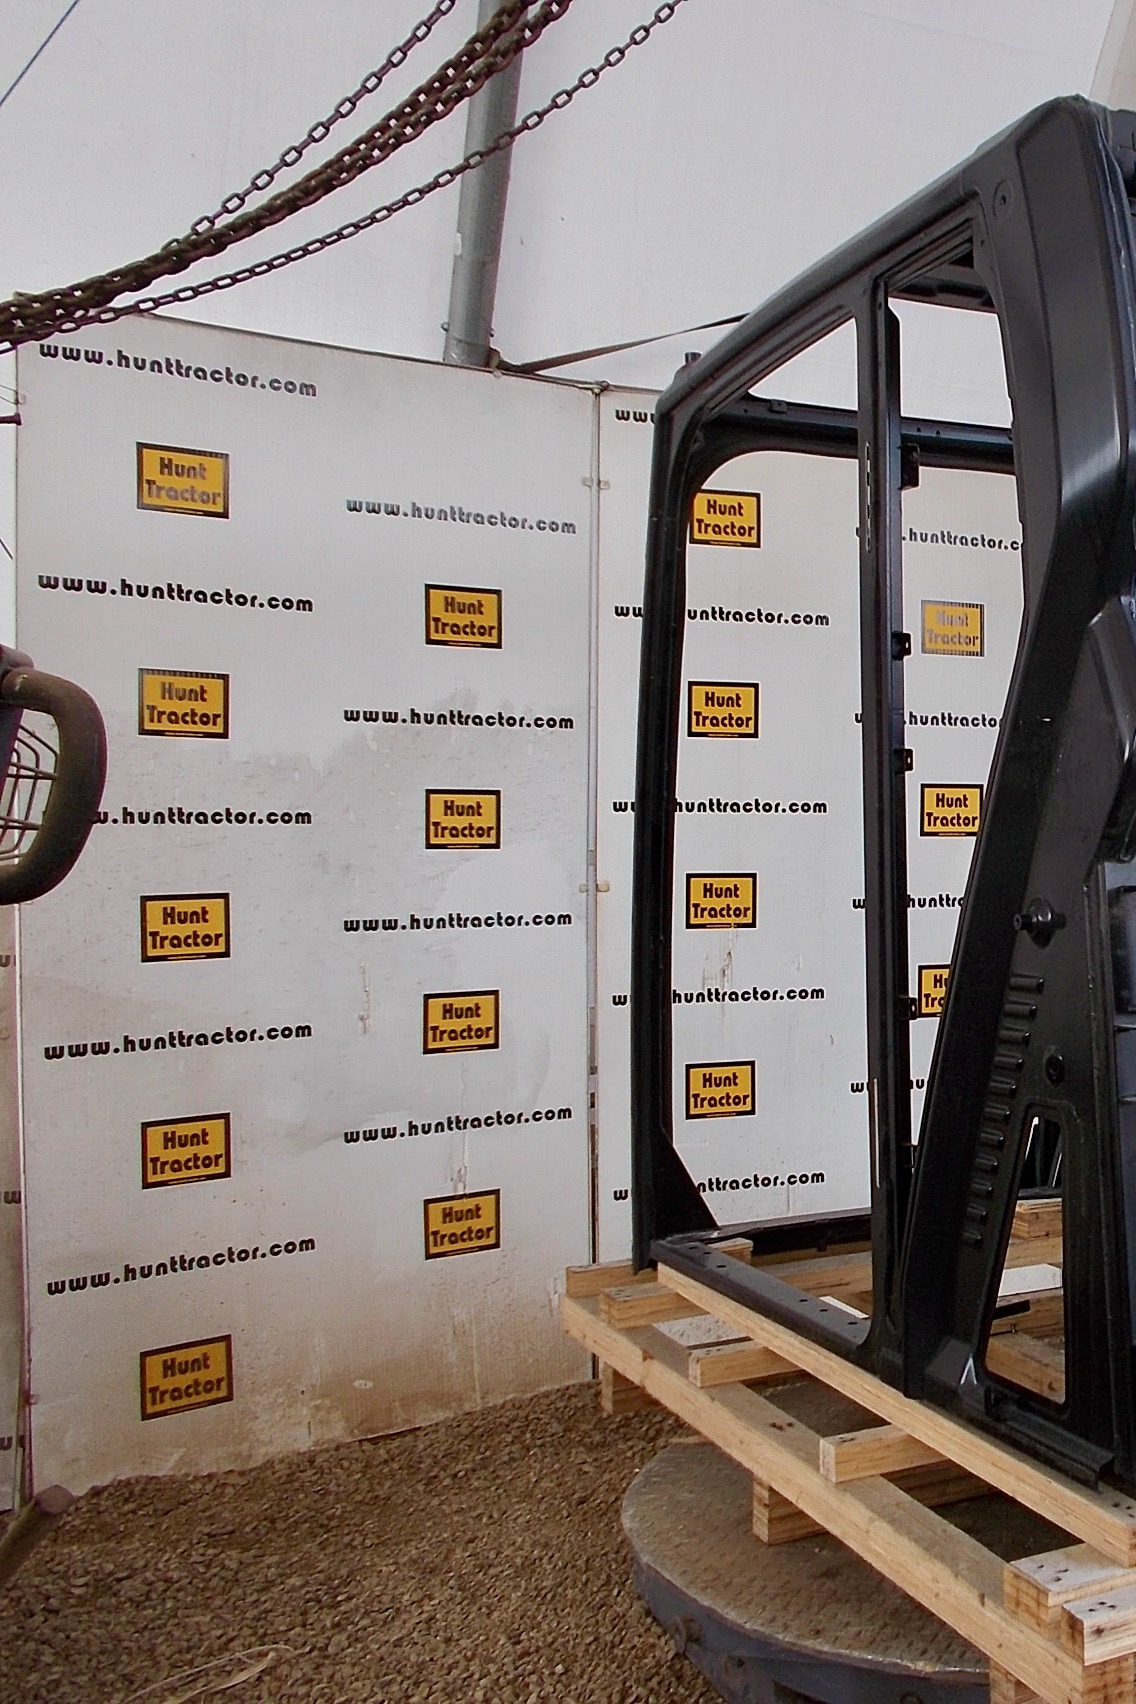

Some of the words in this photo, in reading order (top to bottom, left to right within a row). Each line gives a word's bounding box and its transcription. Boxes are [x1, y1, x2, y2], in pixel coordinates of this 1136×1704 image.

[39, 343, 317, 396] www.hunttractor.com
[159, 457, 206, 479] Hunt
[145, 479, 221, 506] Tractor
[347, 500, 576, 534] www.hunttractor.com
[707, 499, 743, 517] Hunt
[696, 517, 755, 537] Tractor
[38, 575, 313, 612] www.hunttractor.com
[444, 596, 484, 615] Hunt
[433, 617, 496, 637] Tractor
[161, 682, 207, 702] Hunt
[705, 691, 741, 708] Hunt
[146, 705, 221, 728] Tractor
[344, 708, 573, 729] www.hunttractor.com
[695, 711, 752, 729] Tractor
[444, 800, 482, 816] Hunt
[936, 793, 968, 808] Hunt
[433, 821, 494, 838] Tractor
[927, 812, 978, 827] Tractor
[703, 883, 739, 898] Hunt
[163, 906, 209, 925] Hunt
[692, 902, 750, 918] Tractor
[344, 912, 572, 932] www.hunttractor.com
[149, 929, 223, 951] Tractor
[442, 1003, 481, 1020] Hunt
[44, 1025, 312, 1060] www.hunttractor.com
[431, 1023, 493, 1043] Tractor
[703, 1072, 738, 1088] Hunt
[693, 1091, 750, 1109] Tractor
[344, 1108, 572, 1143] www.hunttractor.com
[163, 1128, 209, 1150] Hunt
[150, 1152, 223, 1176] Tractor
[442, 1204, 481, 1224] Hunt
[431, 1226, 495, 1252] Tractor
[47, 1238, 315, 1295] www.hunttractor.com
[162, 1352, 210, 1378] Hunt
[149, 1375, 225, 1405] Tractor
